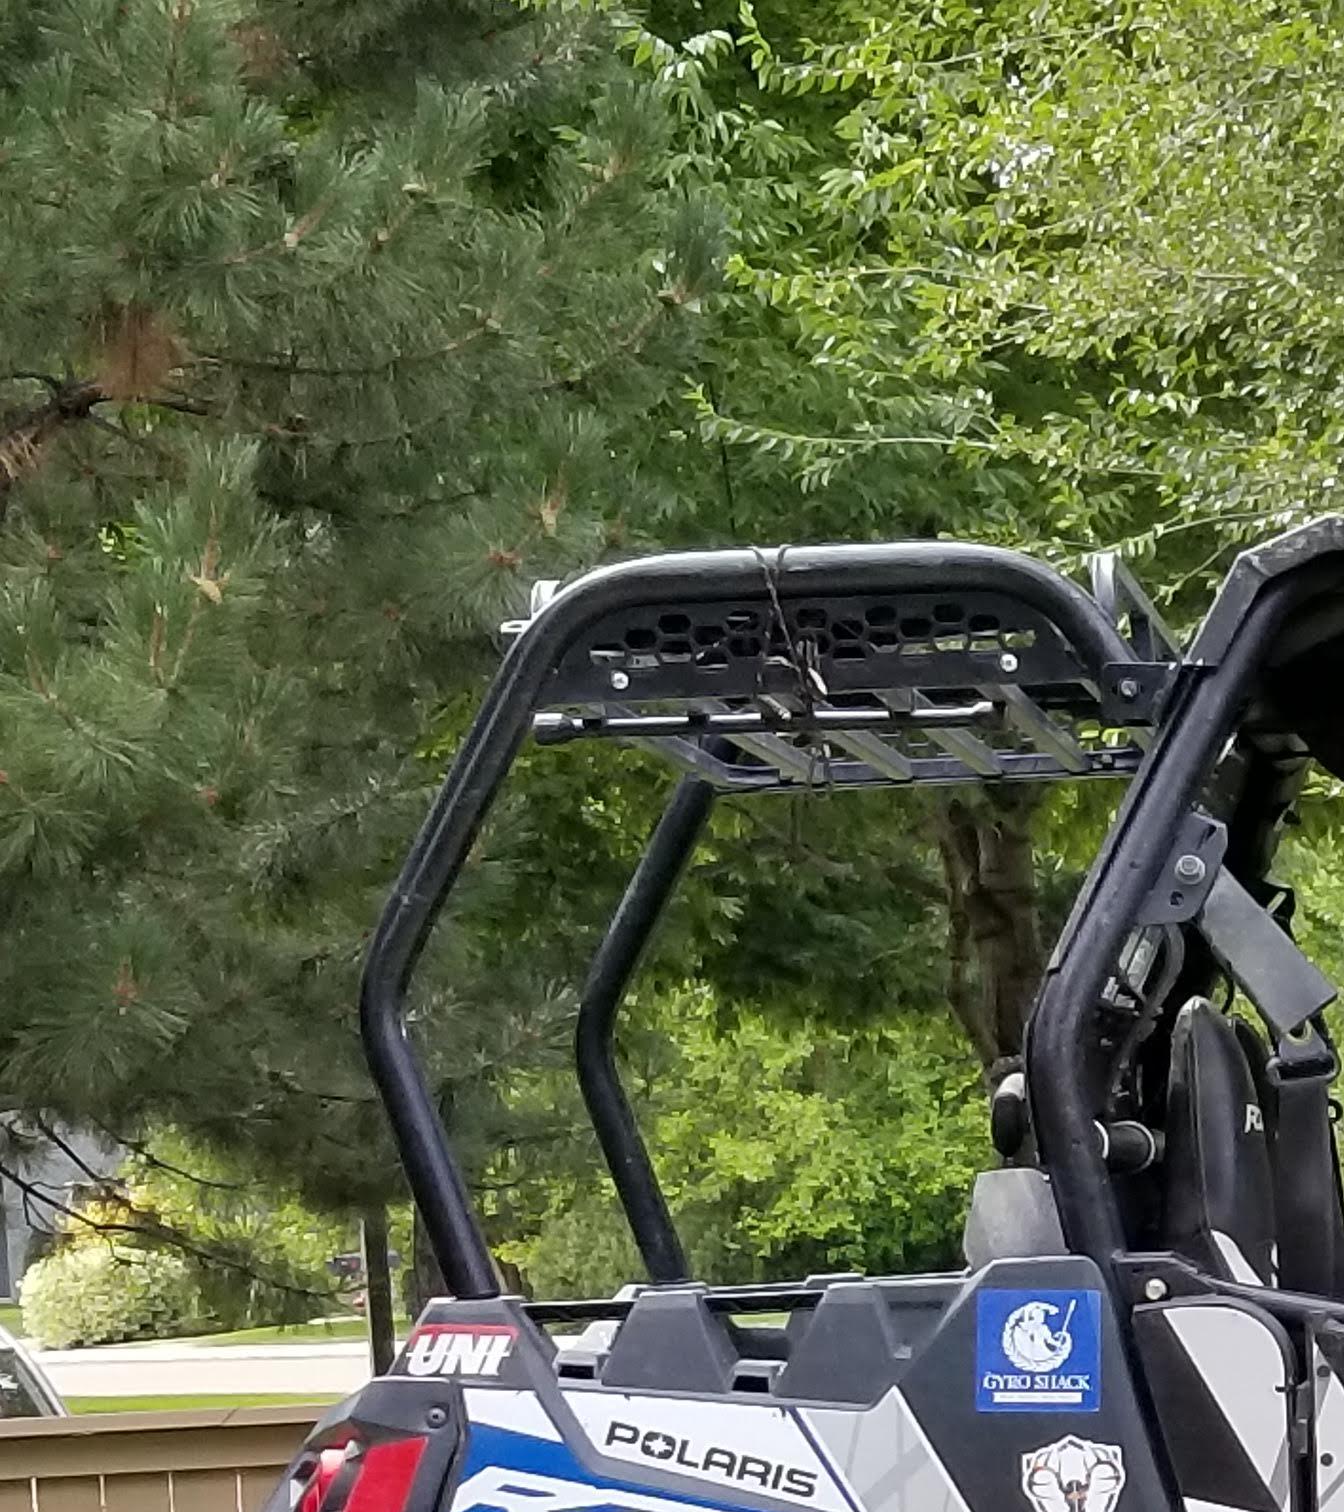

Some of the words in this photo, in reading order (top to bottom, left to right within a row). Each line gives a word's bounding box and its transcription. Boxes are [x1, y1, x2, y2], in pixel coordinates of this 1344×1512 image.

[406, 1332, 511, 1376] UNI
[983, 1373, 1031, 1390] GYRO
[1033, 1374, 1091, 1390] SHACK
[604, 1420, 819, 1498] POLARIS
